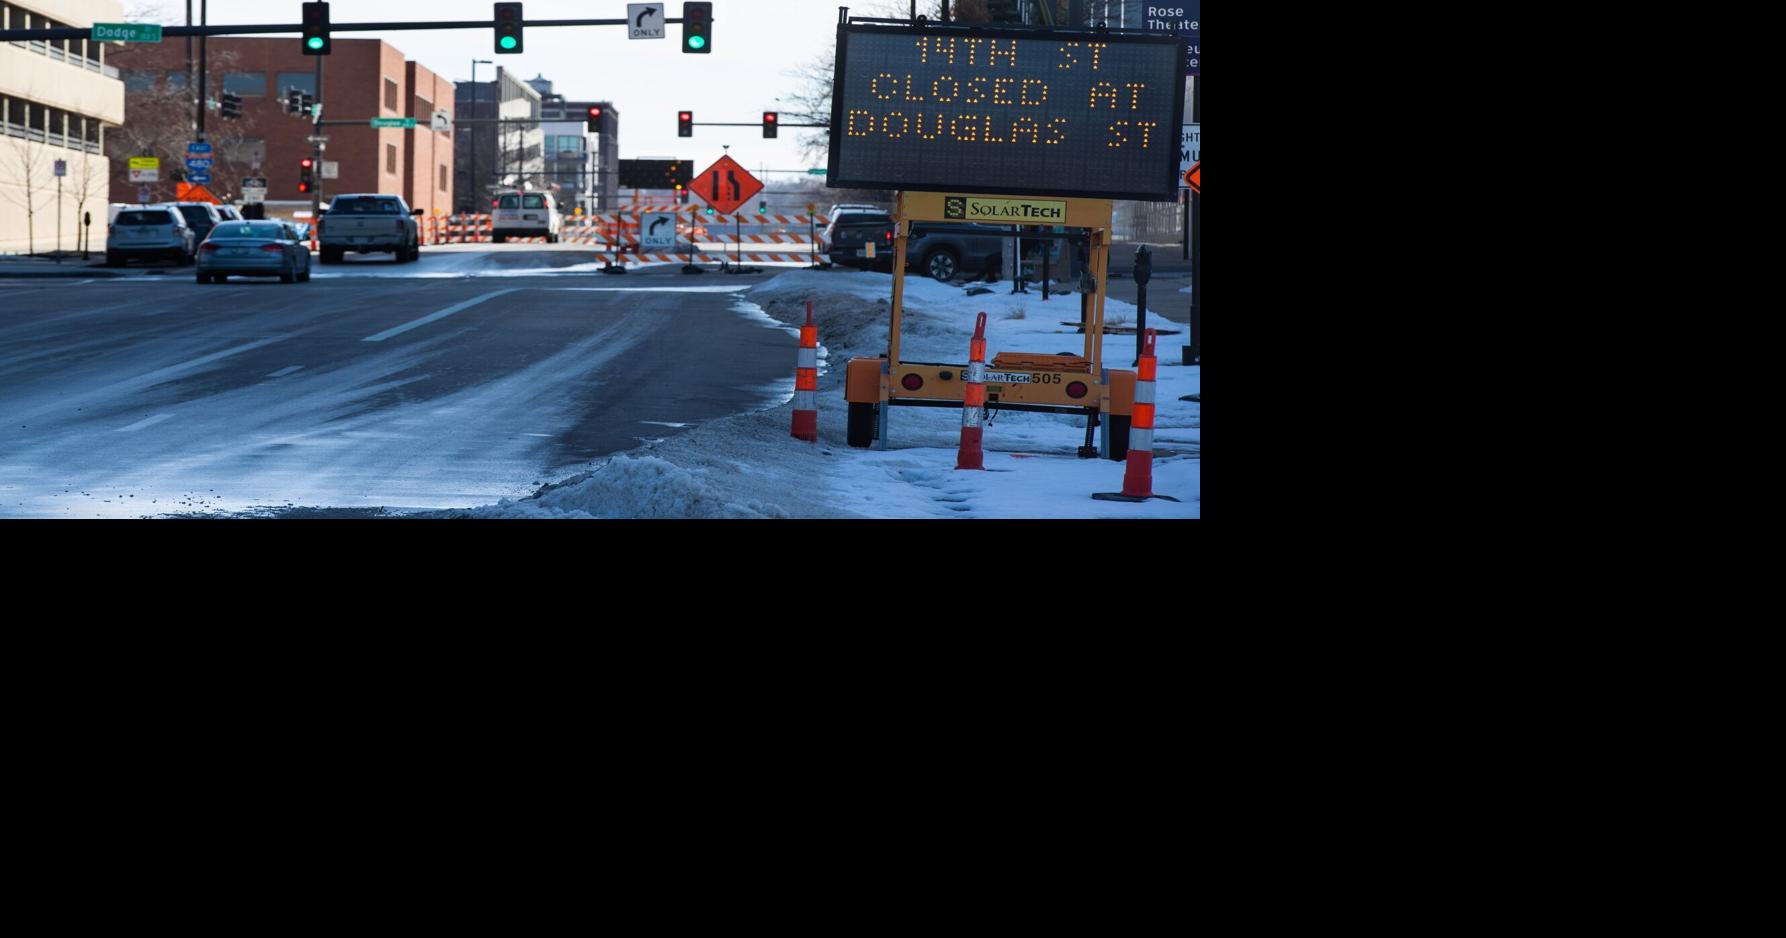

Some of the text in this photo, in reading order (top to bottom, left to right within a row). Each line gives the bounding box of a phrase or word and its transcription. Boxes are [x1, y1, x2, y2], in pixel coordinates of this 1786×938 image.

[1148, 6, 1184, 17] Rose
[96, 26, 137, 40] Dodge
[633, 29, 660, 37] ONLY
[916, 36, 1107, 69] 14TH ST
[871, 73, 1145, 109] CLOSED AT
[848, 110, 1157, 148] DOUGLAS ST
[188, 160, 210, 168] 480
[971, 202, 1060, 218] SOLARTECH
[645, 237, 672, 245] ONLY
[1032, 373, 1062, 384] 505
